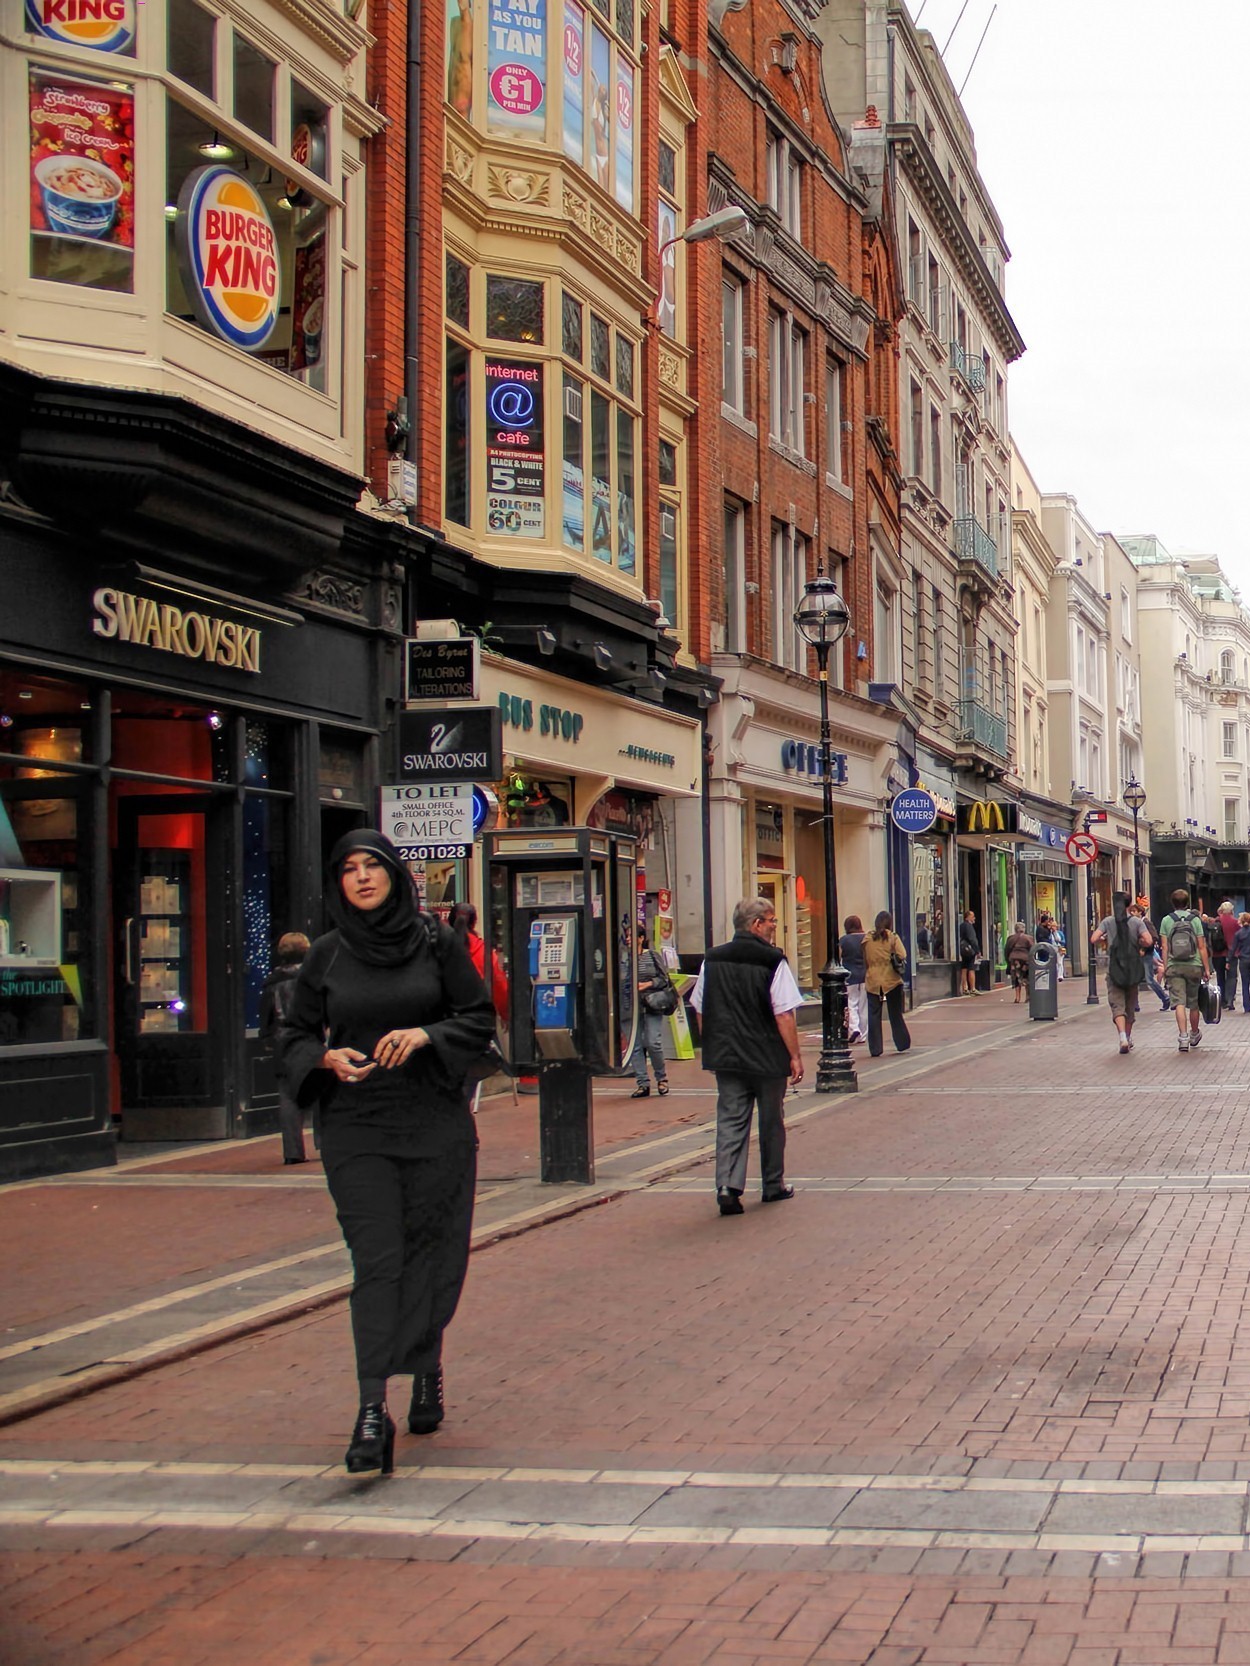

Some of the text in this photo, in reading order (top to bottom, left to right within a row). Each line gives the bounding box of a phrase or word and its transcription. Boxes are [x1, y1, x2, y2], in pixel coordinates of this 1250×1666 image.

[43, 0, 125, 24] KING
[493, 10, 542, 30] AS YOU
[492, 26, 542, 58] TAN
[506, 66, 528, 77] ONLY
[499, 74, 532, 102] €1
[502, 99, 531, 112] PER MIN
[205, 209, 274, 257] BURGER
[204, 243, 277, 298] KING
[485, 364, 539, 382] internet
[496, 430, 530, 446] cafe
[490, 457, 544, 471] BLACK & WHITE
[491, 467, 516, 491] 5
[516, 477, 542, 487] CENT
[488, 497, 542, 513] COLOUR
[488, 509, 542, 532] 60 CENT
[92, 586, 262, 674] SWAROVSKI
[416, 666, 466, 680] TAILORING
[498, 691, 584, 744] BUS STOP
[404, 752, 488, 771] SWAROVSKI
[392, 785, 463, 800] TO LET
[402, 801, 455, 811] SMALL OFFICE
[899, 799, 930, 808] HEALTH
[391, 811, 404, 819] 4th
[404, 810, 431, 819] FLOOR
[431, 810, 442, 818] 54
[895, 810, 934, 821] MATTERS
[410, 819, 464, 838] MEPC
[399, 846, 467, 860] 2601028
[1, 979, 67, 996] SPOTLIGHT
